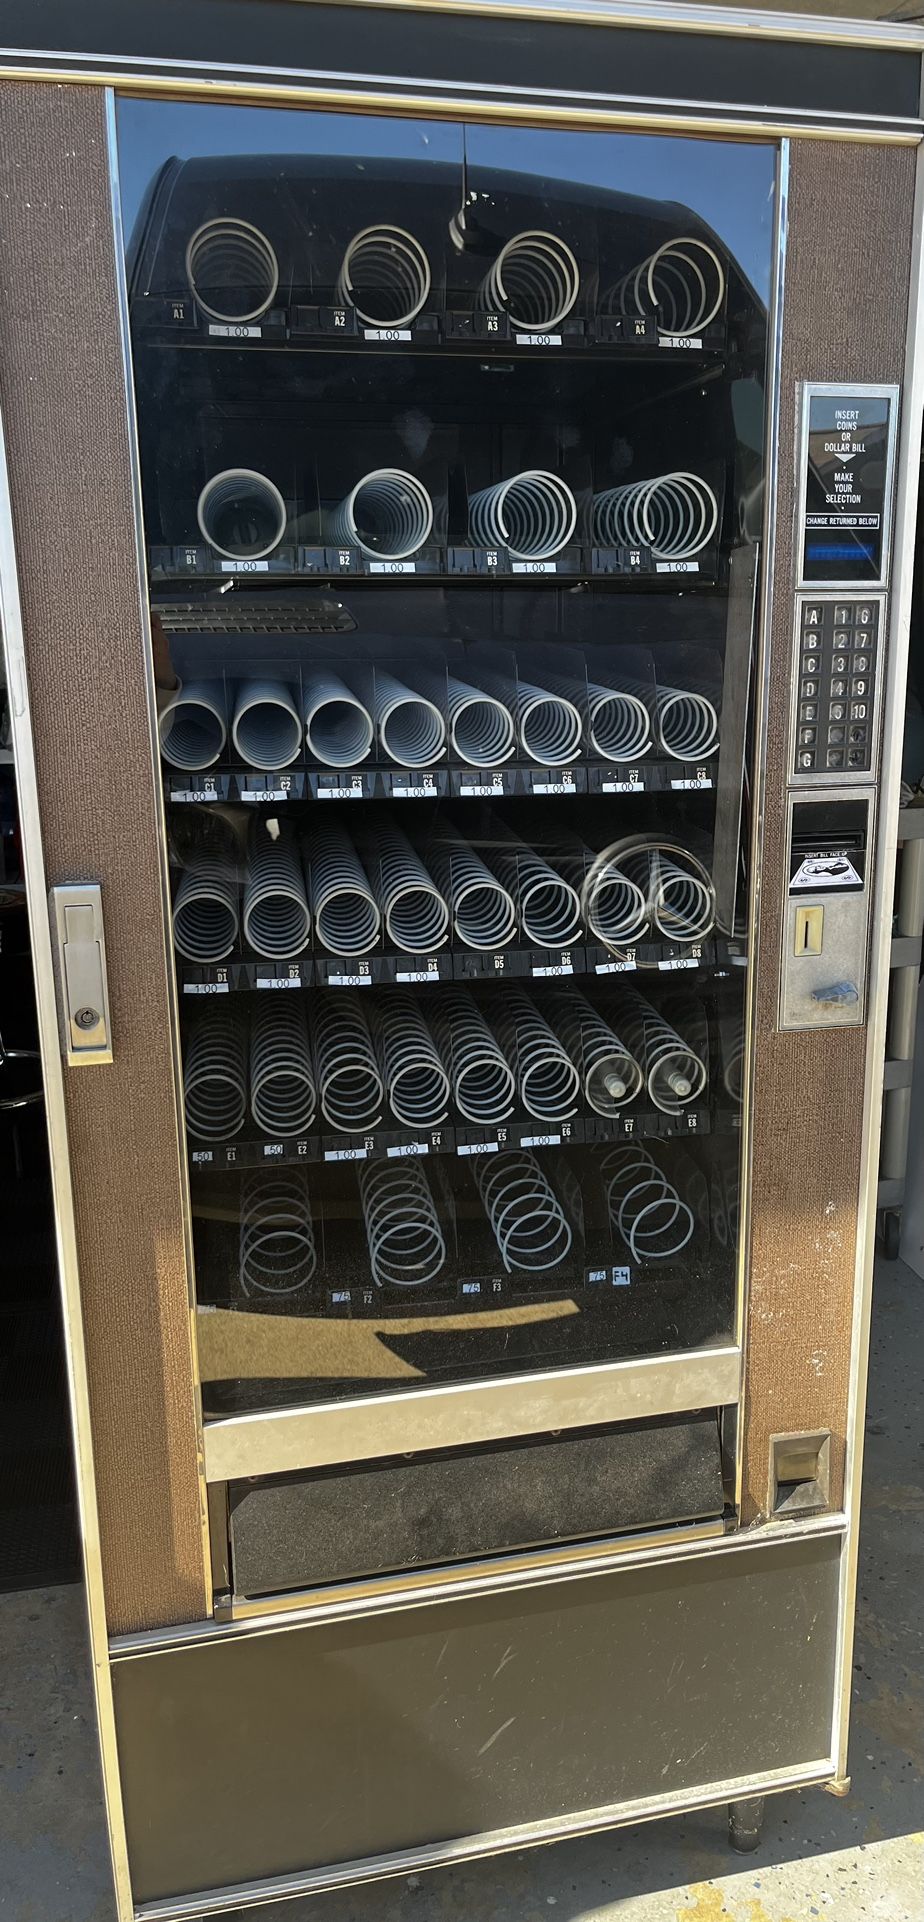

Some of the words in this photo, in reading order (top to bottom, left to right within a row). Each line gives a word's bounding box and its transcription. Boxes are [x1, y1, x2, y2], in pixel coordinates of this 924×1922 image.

[174, 308, 184, 319] A1
[335, 316, 345, 326] A2
[488, 321, 498, 332] A3
[636, 325, 645, 335] A4
[835, 410, 859, 419] INSERT
[837, 422, 856, 430] COINS
[842, 433, 851, 441] OR
[825, 443, 850, 452] DOLLAR
[852, 444, 865, 452] BILL
[834, 473, 853, 482] MAKE
[835, 484, 852, 492] YOUR
[826, 494, 861, 503] SELECTION
[186, 555, 196, 564] B1
[340, 555, 350, 565] B2
[487, 556, 497, 566] B3
[631, 555, 640, 565] B4
[810, 610, 817, 624] A
[841, 610, 846, 624] 1
[861, 610, 868, 624] 6
[809, 635, 817, 648] B
[838, 634, 845, 648] 2
[860, 634, 867, 648] 7
[808, 659, 815, 672] C
[838, 658, 844, 671] 3
[859, 657, 866, 671] 8
[807, 683, 814, 696] D
[836, 682, 843, 695] 4
[858, 681, 864, 695] 9
[806, 707, 813, 720] E
[854, 705, 865, 718] 10
[805, 730, 812, 743] F
[803, 754, 810, 767] G
[423, 779, 433, 787] C4
[562, 776, 572, 784] C6
[630, 774, 638, 783] C7
[205, 782, 214, 791] C1
[281, 781, 290, 791] C2
[352, 780, 362, 790] C3
[495, 960, 504, 969] D5
[562, 956, 570, 965] D6
[360, 966, 369, 974] D3
[428, 963, 437, 971] D4
[218, 973, 227, 982] D1
[289, 969, 299, 978] D2
[625, 1123, 633, 1131] E7
[688, 1119, 696, 1127] E8
[498, 1133, 507, 1141] E5
[563, 1128, 571, 1136] E6
[365, 1141, 374, 1149] E3
[432, 1136, 441, 1145] E4
[227, 1152, 236, 1160] E1
[614, 1271, 628, 1282] F4
